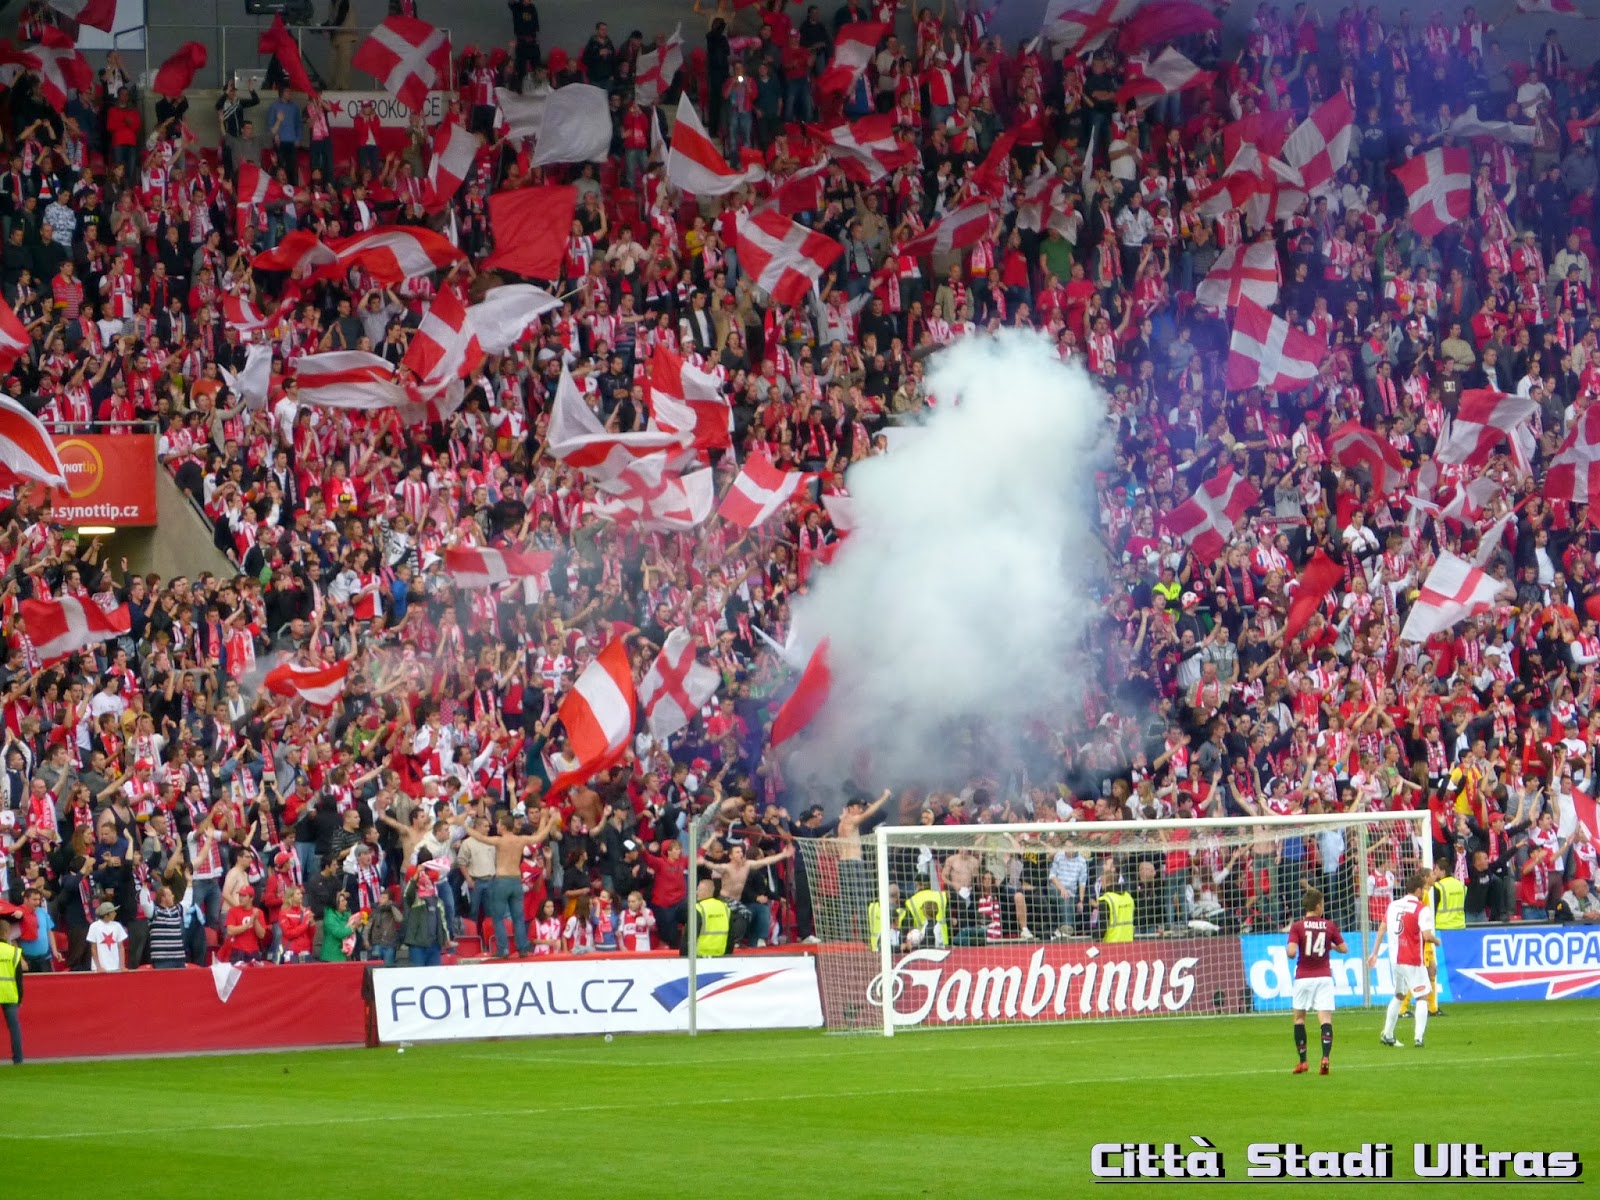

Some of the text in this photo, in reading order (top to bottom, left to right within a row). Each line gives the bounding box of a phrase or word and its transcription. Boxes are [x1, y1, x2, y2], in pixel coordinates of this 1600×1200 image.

[1394, 911, 1405, 935] 5
[1305, 930, 1326, 957] 14
[391, 979, 638, 1021] FOTBAL.CZ
[866, 946, 1199, 1025] Gambrinus
